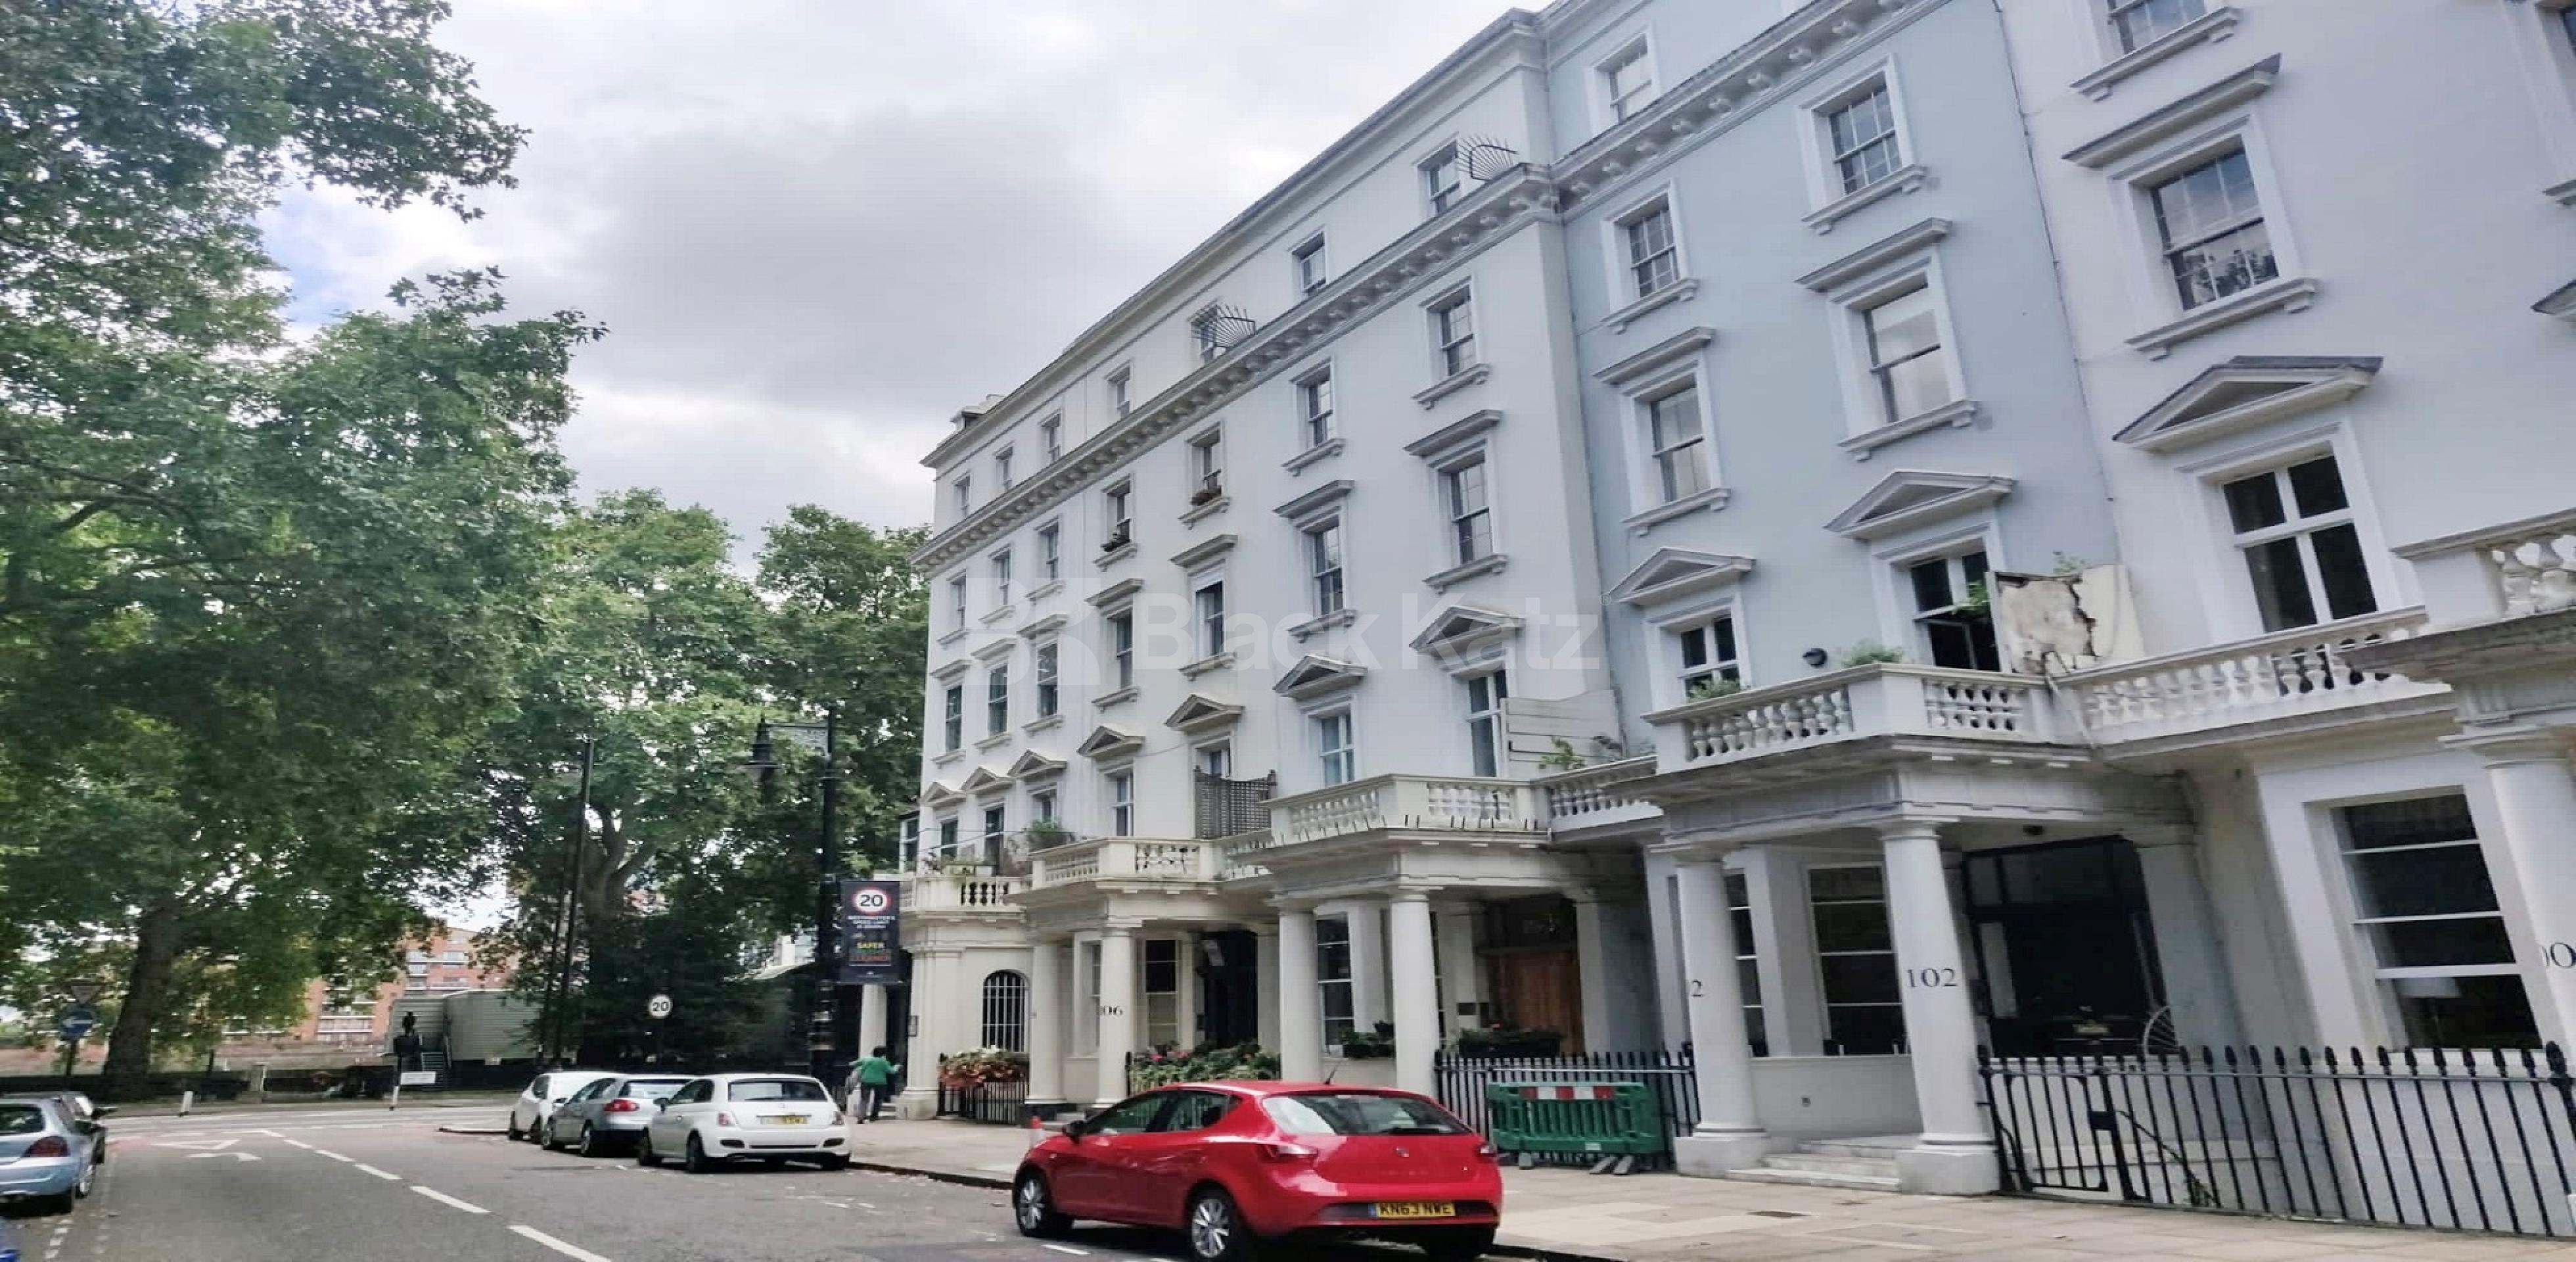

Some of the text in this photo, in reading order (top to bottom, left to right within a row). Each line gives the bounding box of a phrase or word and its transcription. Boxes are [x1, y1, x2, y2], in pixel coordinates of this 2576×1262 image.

[860, 895, 884, 906] 20
[1906, 968, 1958, 987] 102
[1691, 980, 1703, 997] 2
[653, 1001, 668, 1012] 20
[1101, 1006, 1123, 1016] 06
